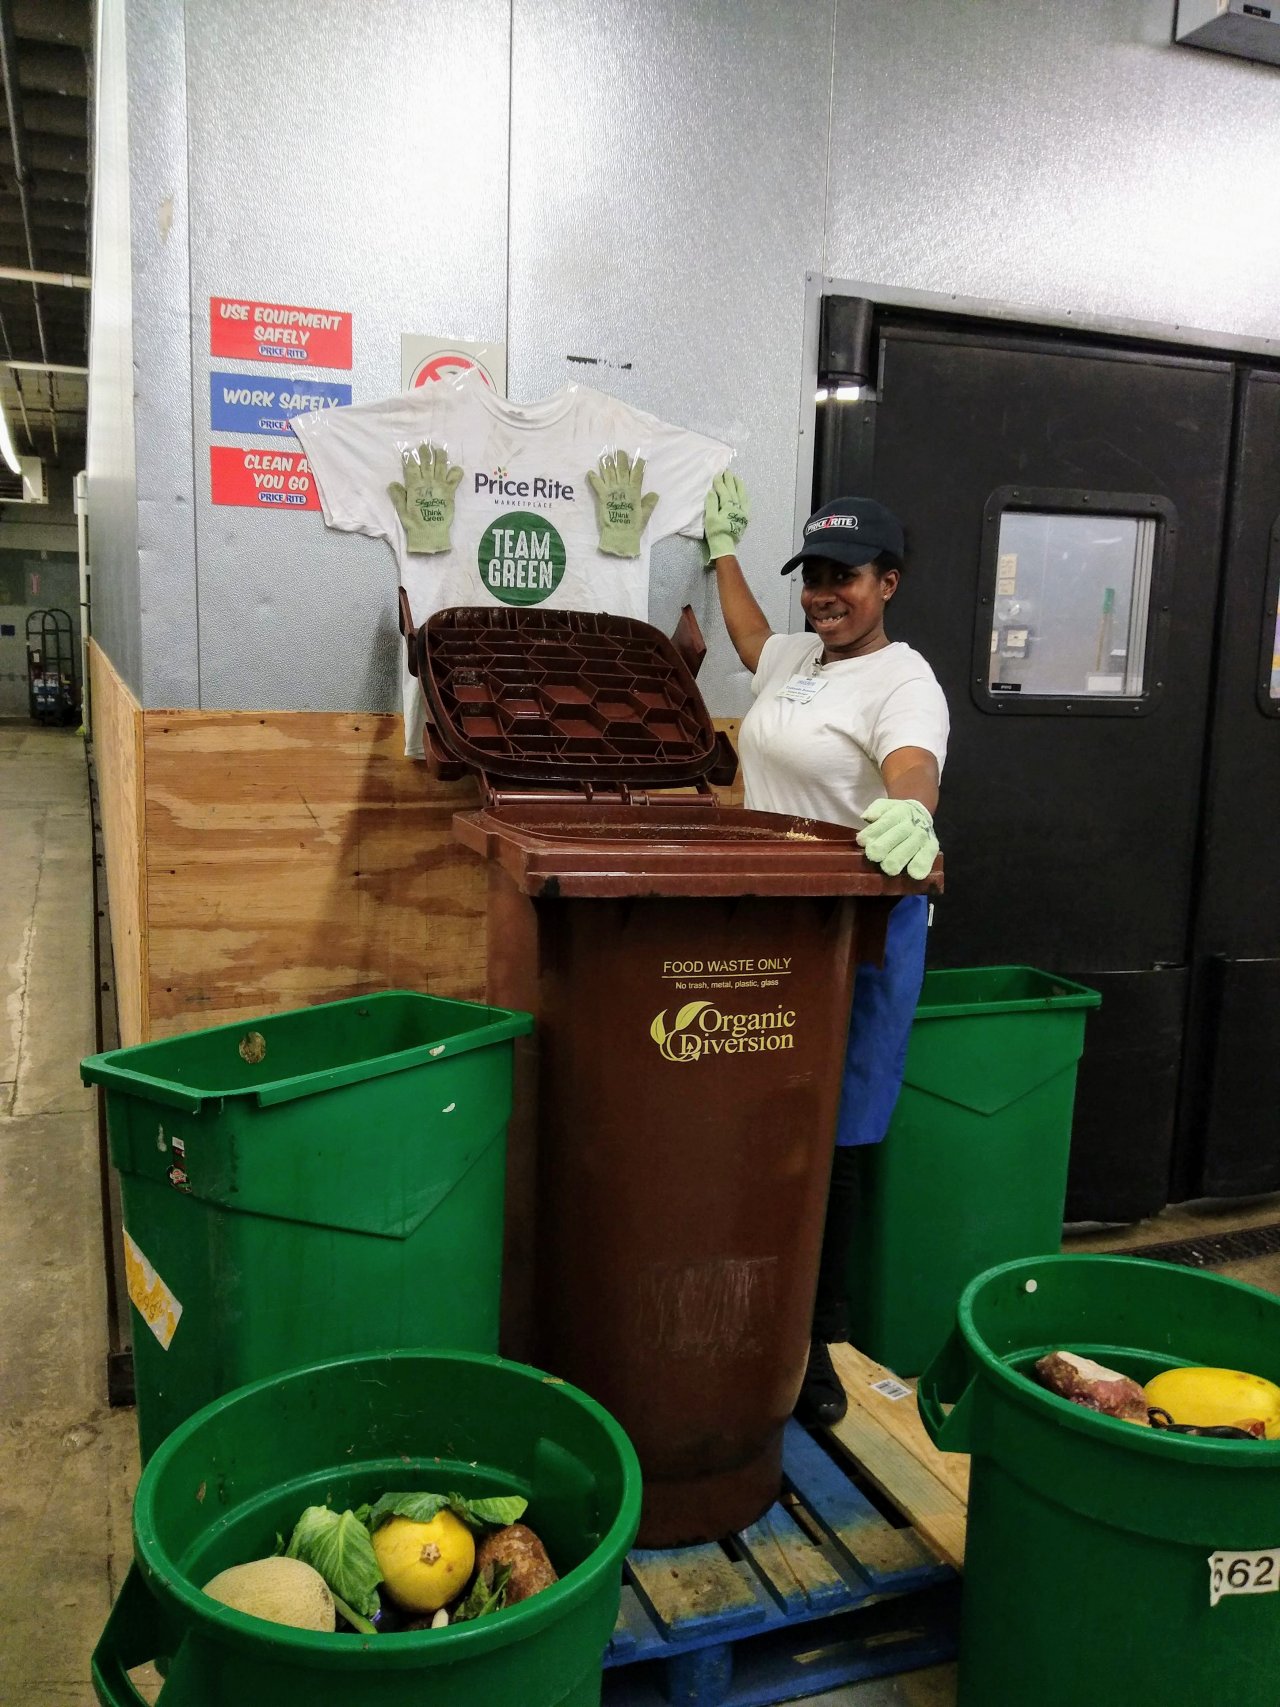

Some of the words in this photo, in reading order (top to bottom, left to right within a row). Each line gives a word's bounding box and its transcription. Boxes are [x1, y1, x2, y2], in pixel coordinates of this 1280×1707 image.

[220, 303, 250, 320] USE
[254, 307, 342, 331] EQUIPMENT
[253, 325, 310, 346] SAFELY
[260, 346, 285, 356] PRICE
[287, 348, 305, 358] RITE
[223, 388, 275, 407] WORK
[260, 419, 284, 429] PRICE
[244, 454, 293, 472] CLEAN
[253, 473, 285, 489] YOU
[288, 475, 309, 491] GO
[474, 472, 529, 497] Price
[533, 477, 574, 501] Rite
[260, 493, 283, 502] PRICE
[286, 495, 304, 503] RITE
[494, 499, 552, 509] MARKETPLACE
[807, 519, 828, 532] PRICE
[831, 518, 853, 526] RITE
[492, 528, 550, 559] TEAM
[488, 559, 553, 589] GREEN
[663, 961, 704, 973] FOOD
[707, 959, 755, 972] WASTE
[758, 957, 792, 970] ONLY
[675, 981, 687, 989] No
[689, 981, 709, 990] trash,
[711, 980, 733, 989] metal,
[735, 979, 759, 989] plastic,
[761, 978, 779, 987] glass
[699, 1004, 796, 1037] Organic
[678, 1030, 794, 1055] Diversion
